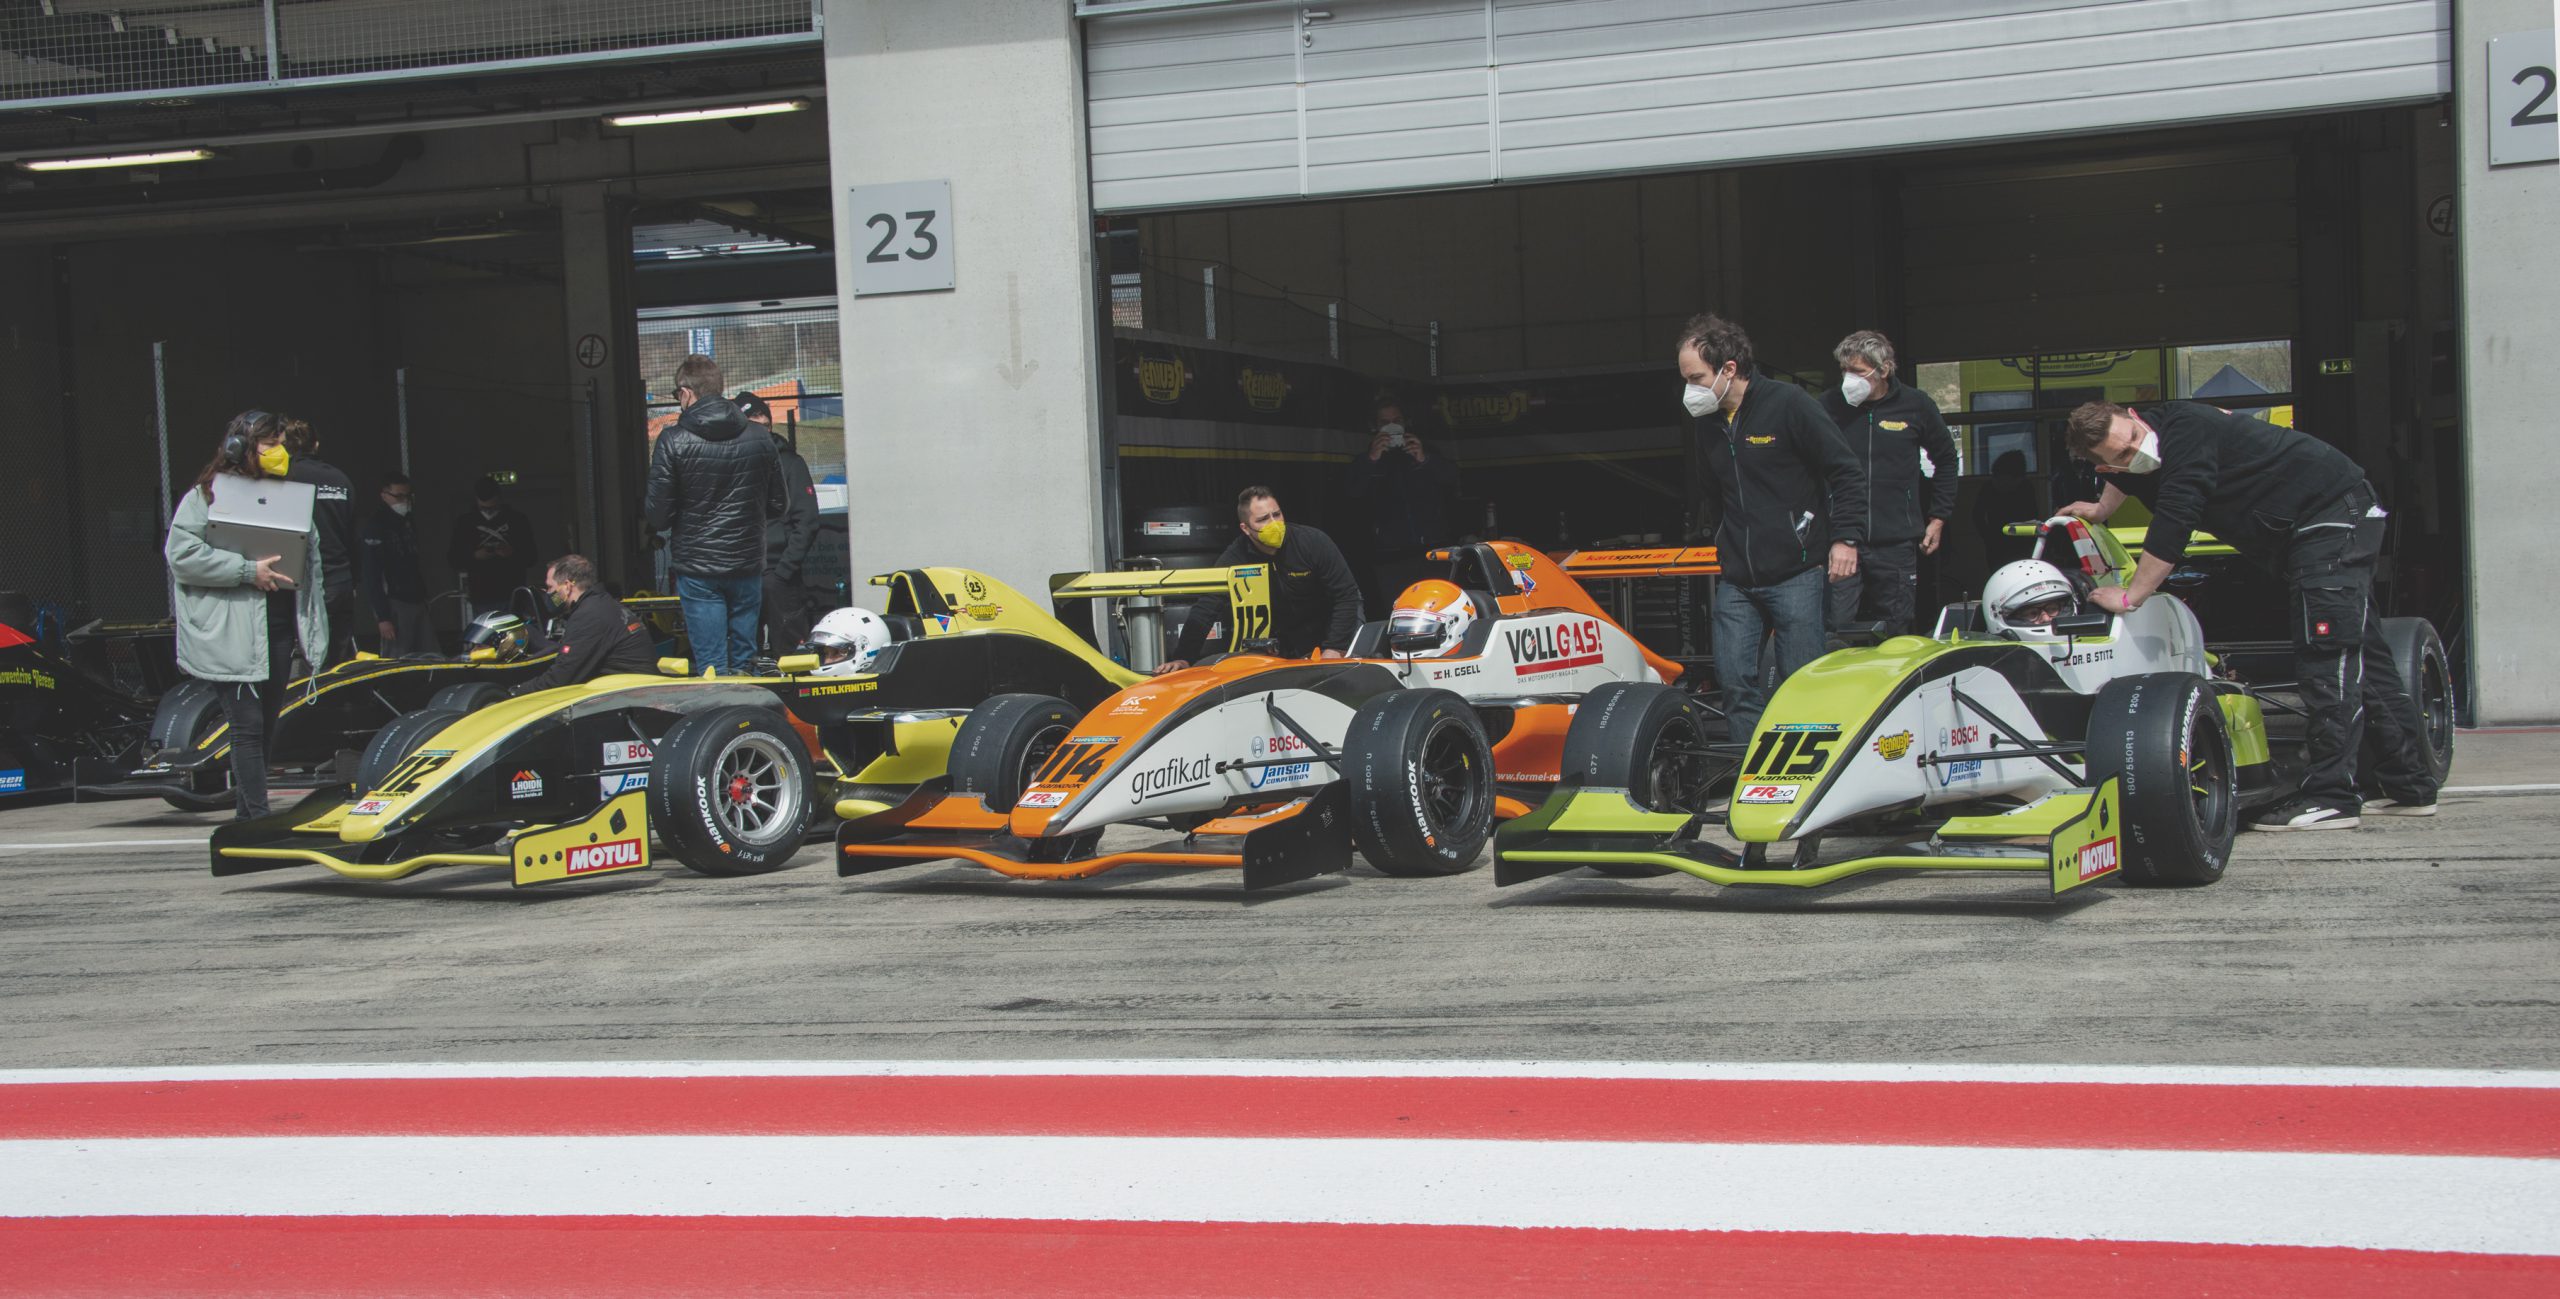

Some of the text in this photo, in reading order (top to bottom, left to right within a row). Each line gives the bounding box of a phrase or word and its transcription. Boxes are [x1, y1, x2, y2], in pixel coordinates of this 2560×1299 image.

[866, 210, 937, 264] 23
[1586, 552, 1670, 561] kartsport.at
[969, 582, 981, 593] 25
[1235, 604, 1271, 653] 112
[1505, 620, 1603, 664] VOLLGAS!
[2095, 649, 2113, 662] STITZ
[0, 667, 31, 684] owerdrive
[1444, 665, 1481, 679] H. GSELL
[1951, 725, 1979, 747] BOSCH
[1033, 743, 1119, 783] 114
[1590, 753, 1599, 775] G77
[1743, 731, 1843, 775] 115
[2125, 730, 2135, 796] 180/550R13
[376, 756, 453, 793] 112
[604, 773, 648, 797] Jan
[1131, 753, 1211, 805] grafik.at
[1251, 761, 1310, 789] Jansen
[1941, 759, 1982, 787] Jansen
[569, 841, 640, 871] MOTUL
[2081, 841, 2115, 875] MOTUL
